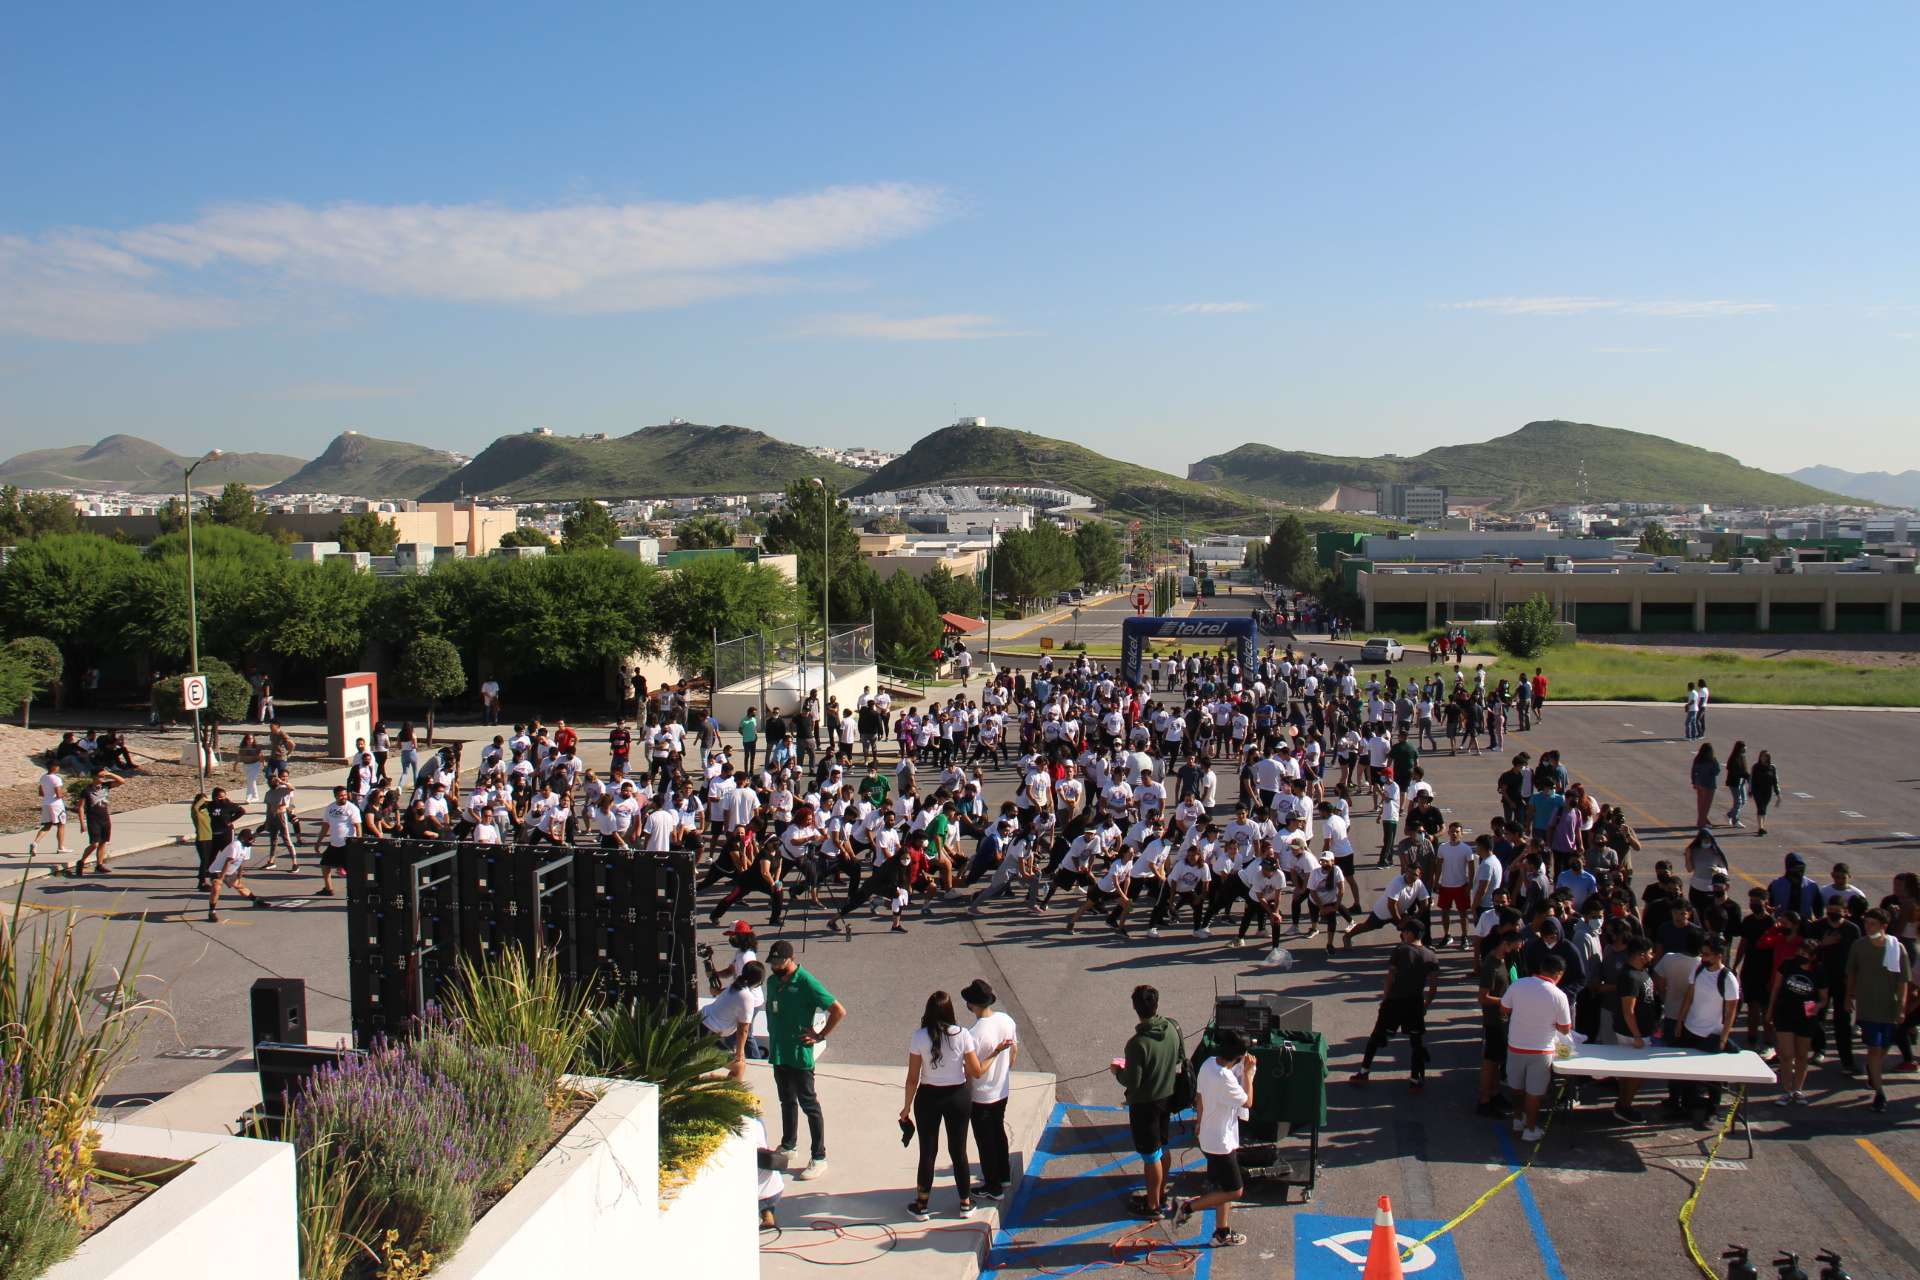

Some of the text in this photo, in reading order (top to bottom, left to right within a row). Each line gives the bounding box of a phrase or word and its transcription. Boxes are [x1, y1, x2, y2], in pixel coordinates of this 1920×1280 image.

[1176, 622, 1228, 636] telcel
[1128, 635, 1138, 670] telcel
[1243, 635, 1253, 670] telcel
[192, 685, 200, 700] E
